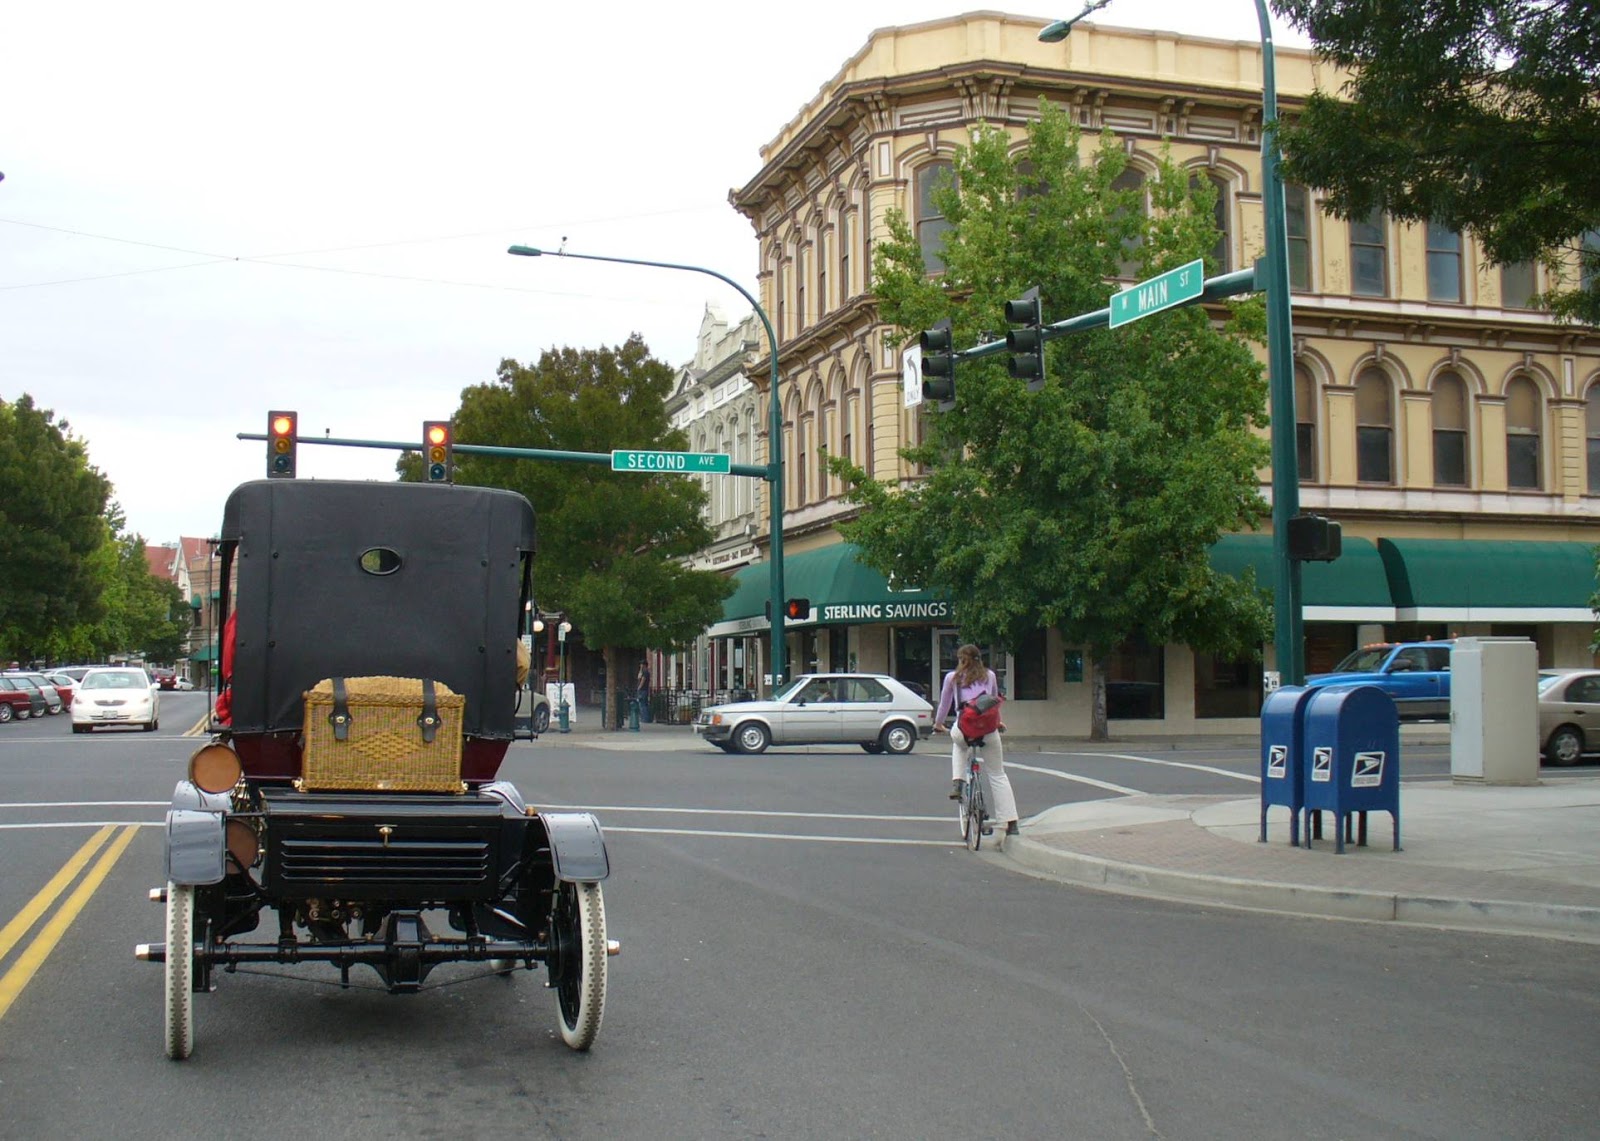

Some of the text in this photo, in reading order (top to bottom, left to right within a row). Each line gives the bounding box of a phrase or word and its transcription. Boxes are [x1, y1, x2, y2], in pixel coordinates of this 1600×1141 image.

[1121, 270, 1190, 312] W MAIN ST
[628, 454, 715, 469] SECOND AVE
[824, 605, 881, 620] STERLING
[885, 602, 947, 618] SAVINGS
